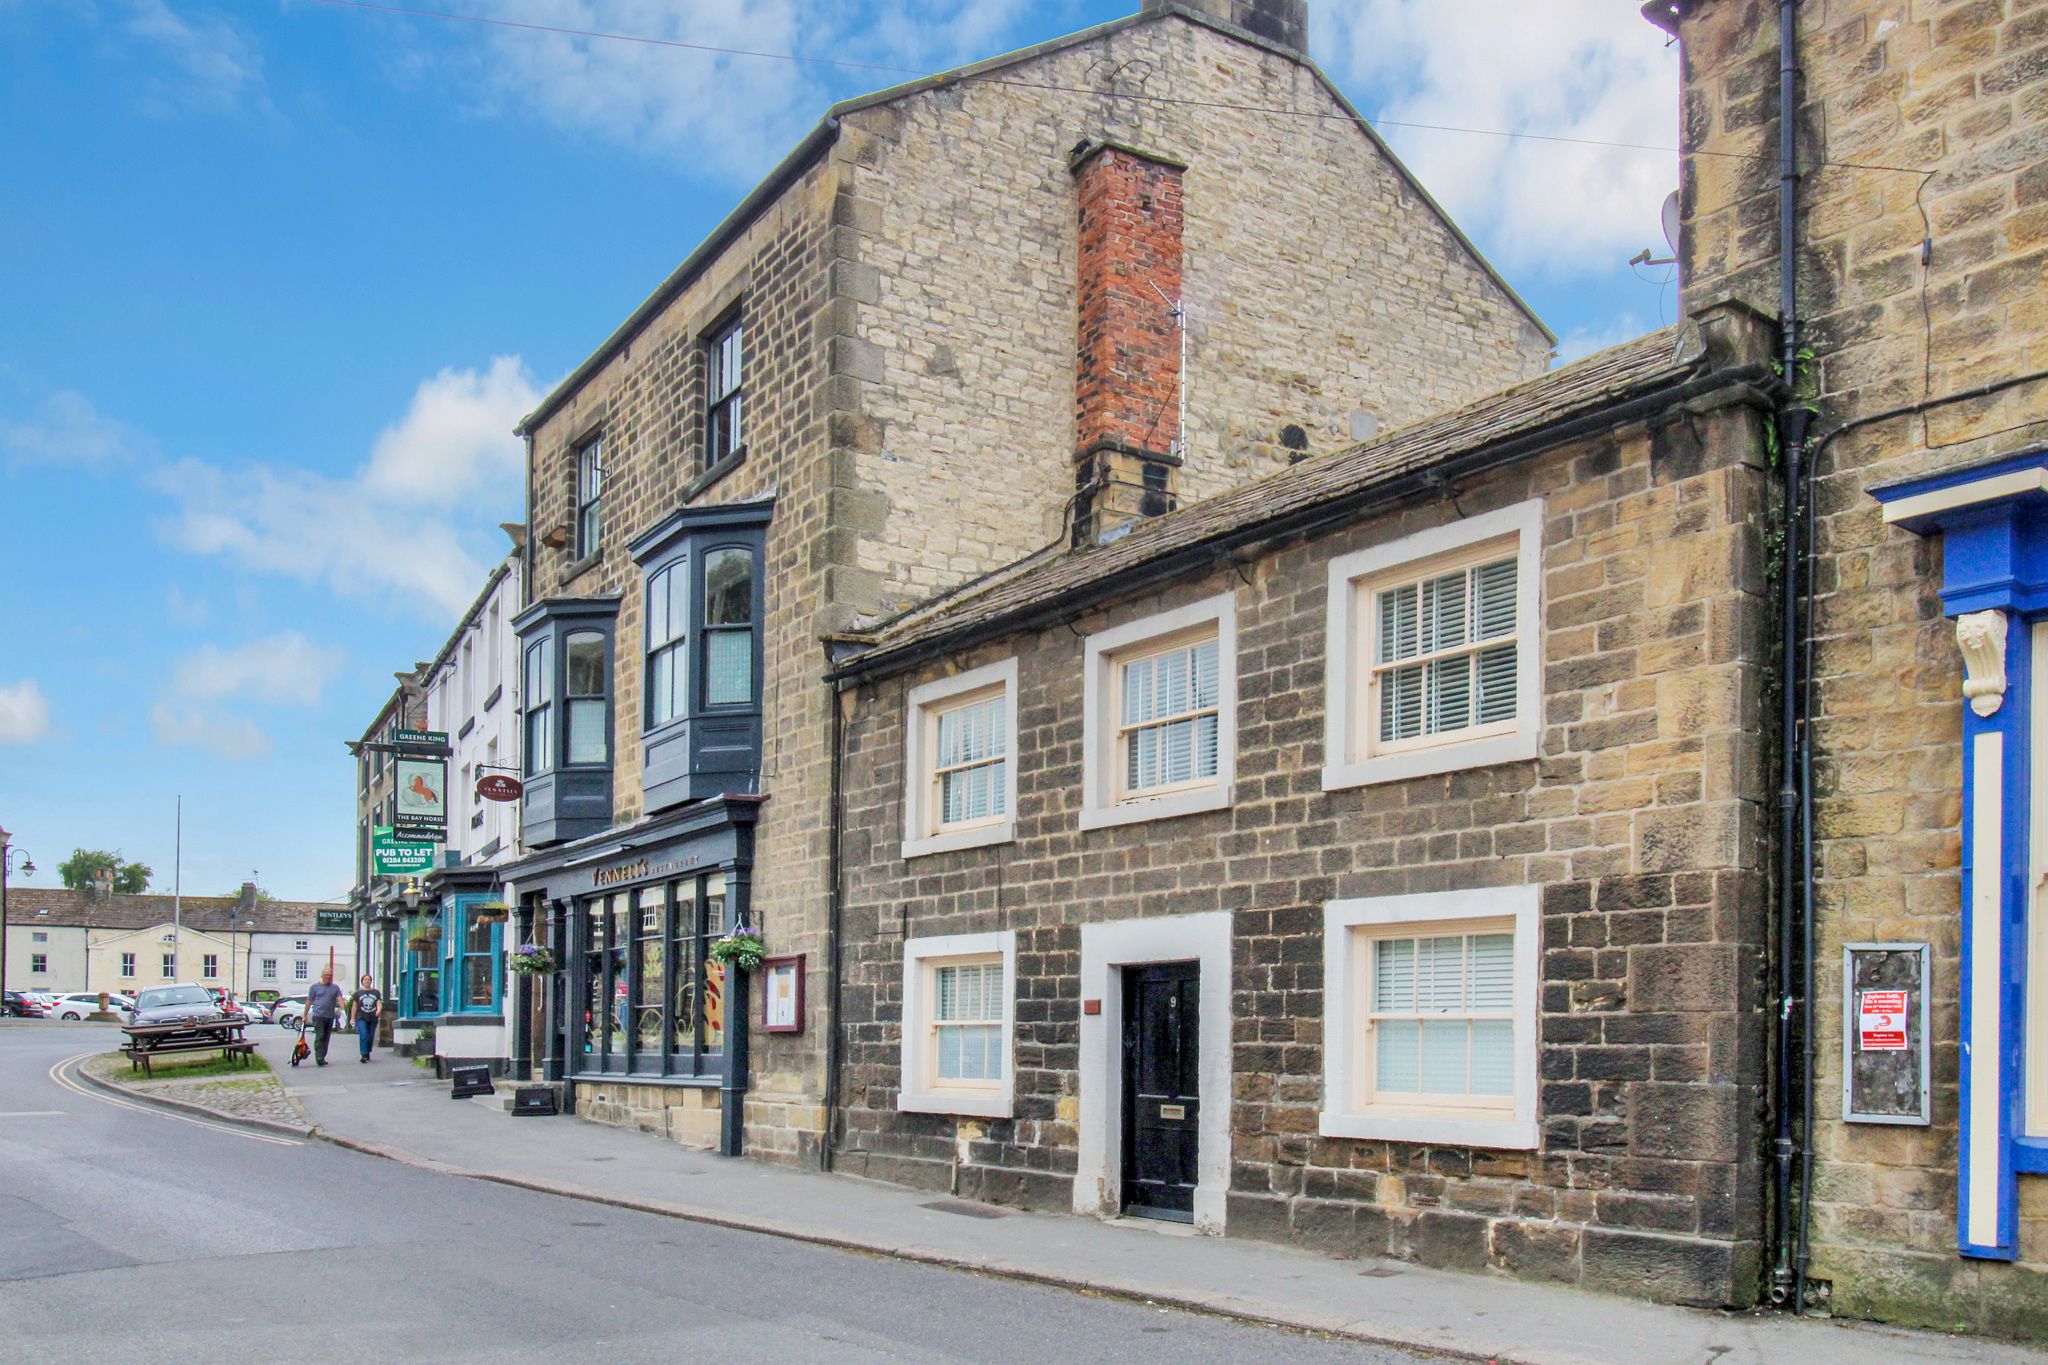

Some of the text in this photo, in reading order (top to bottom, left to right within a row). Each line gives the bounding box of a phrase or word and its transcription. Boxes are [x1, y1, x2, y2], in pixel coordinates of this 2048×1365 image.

[399, 733, 427, 741] GREENE
[375, 848, 433, 857] PUB TO LET
[1170, 996, 1177, 1008] 9
